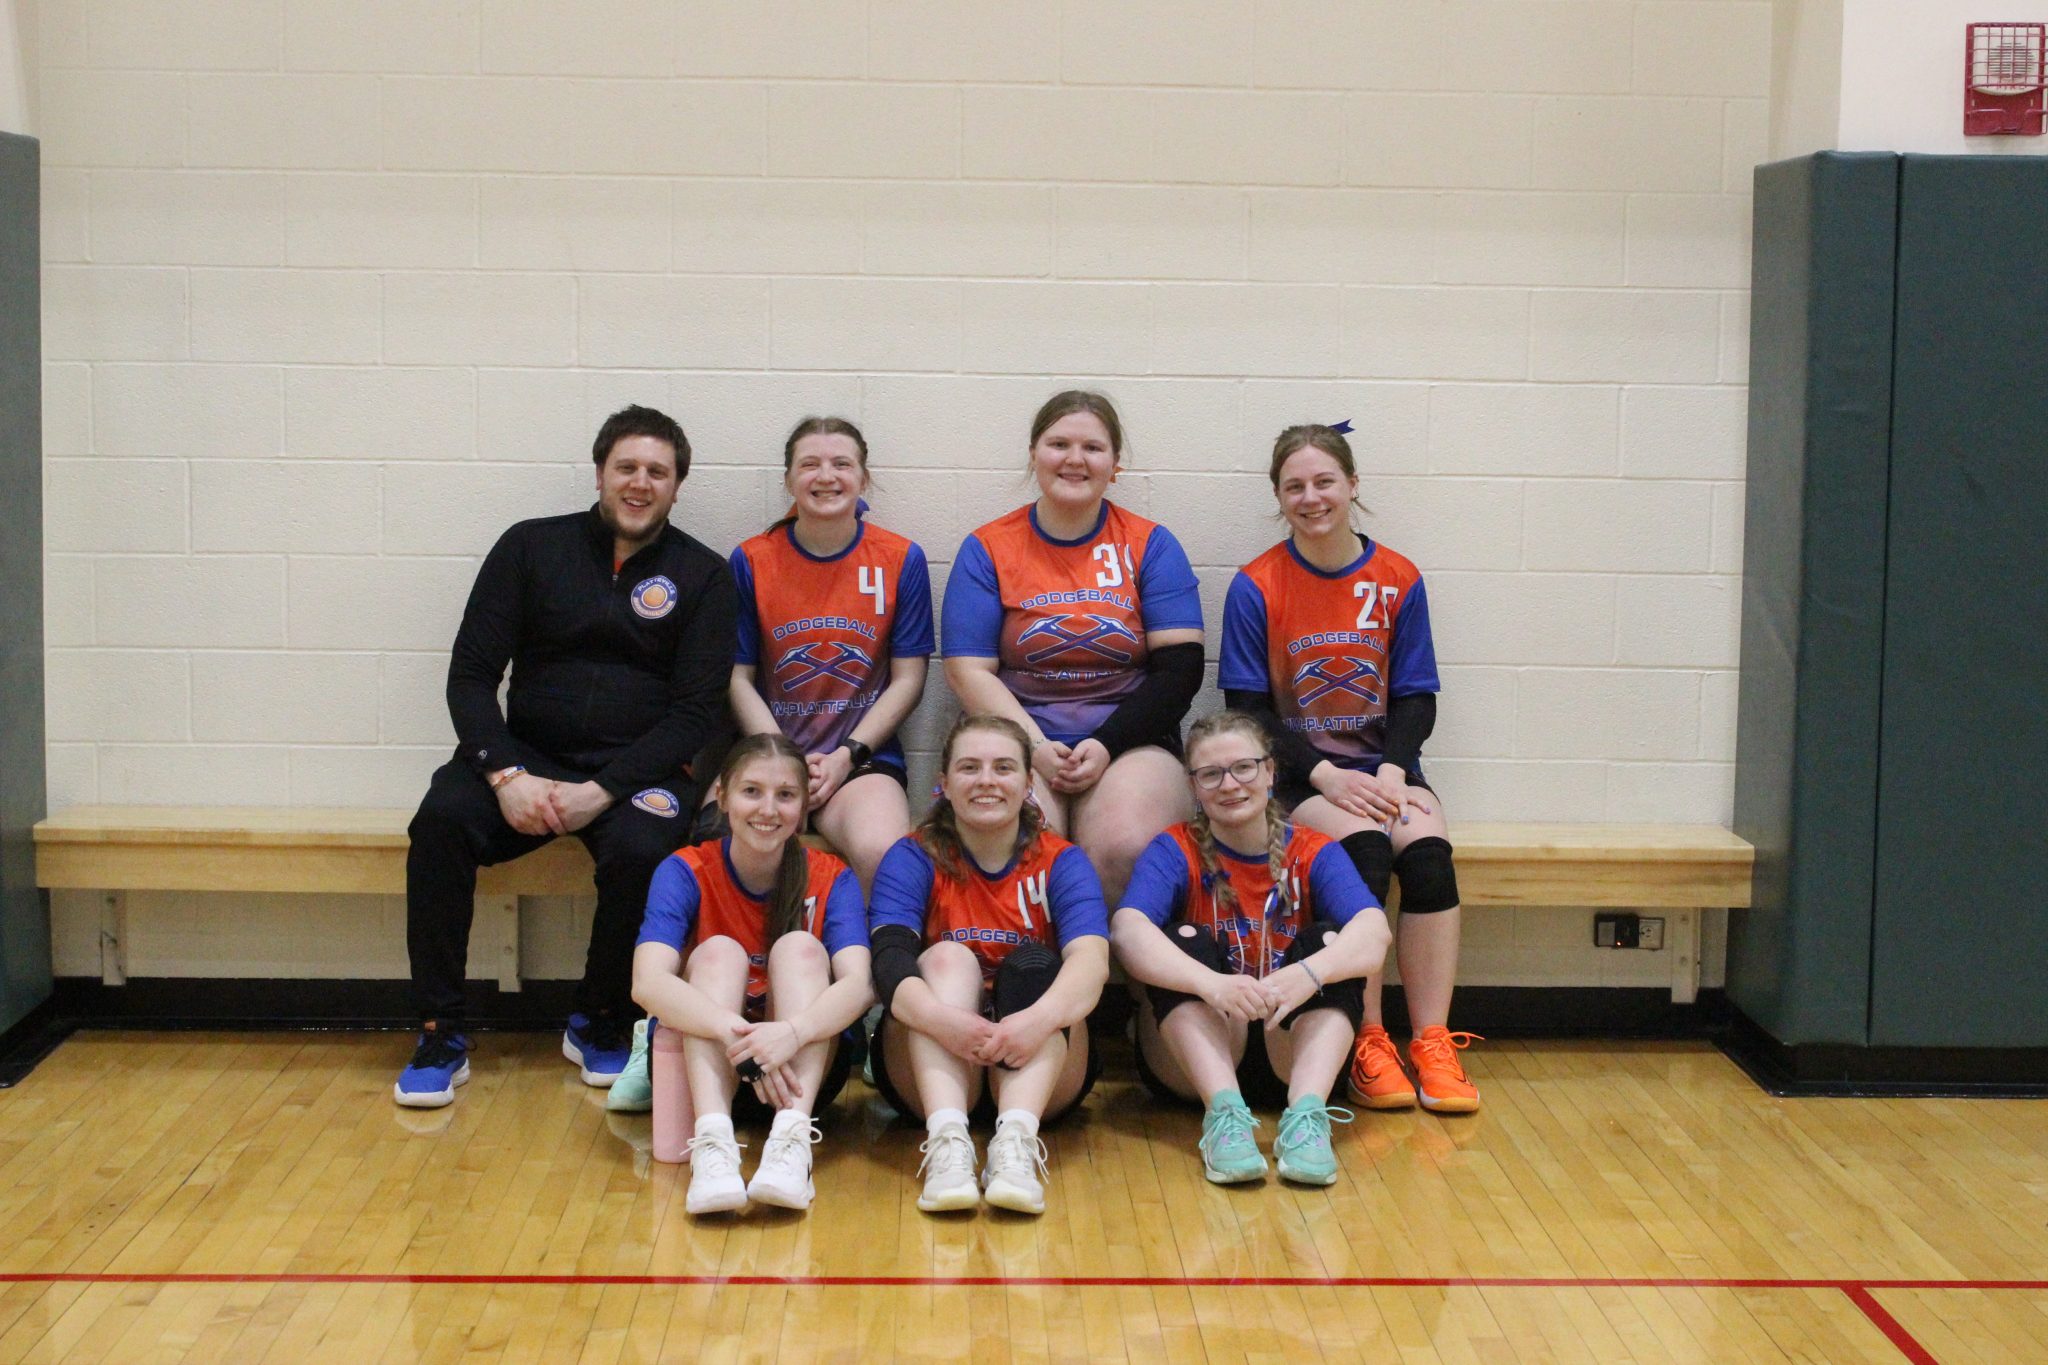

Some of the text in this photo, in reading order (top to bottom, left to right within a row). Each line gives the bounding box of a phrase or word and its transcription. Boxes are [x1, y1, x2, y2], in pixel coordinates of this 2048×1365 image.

[637, 577, 676, 595] PLATTEVILLE
[858, 566, 885, 615] 4
[1020, 589, 1135, 612] DODGEBALL
[772, 615, 877, 641] DODGEBALL
[1287, 632, 1386, 656] DODGEBALL
[1017, 869, 1052, 929] 14
